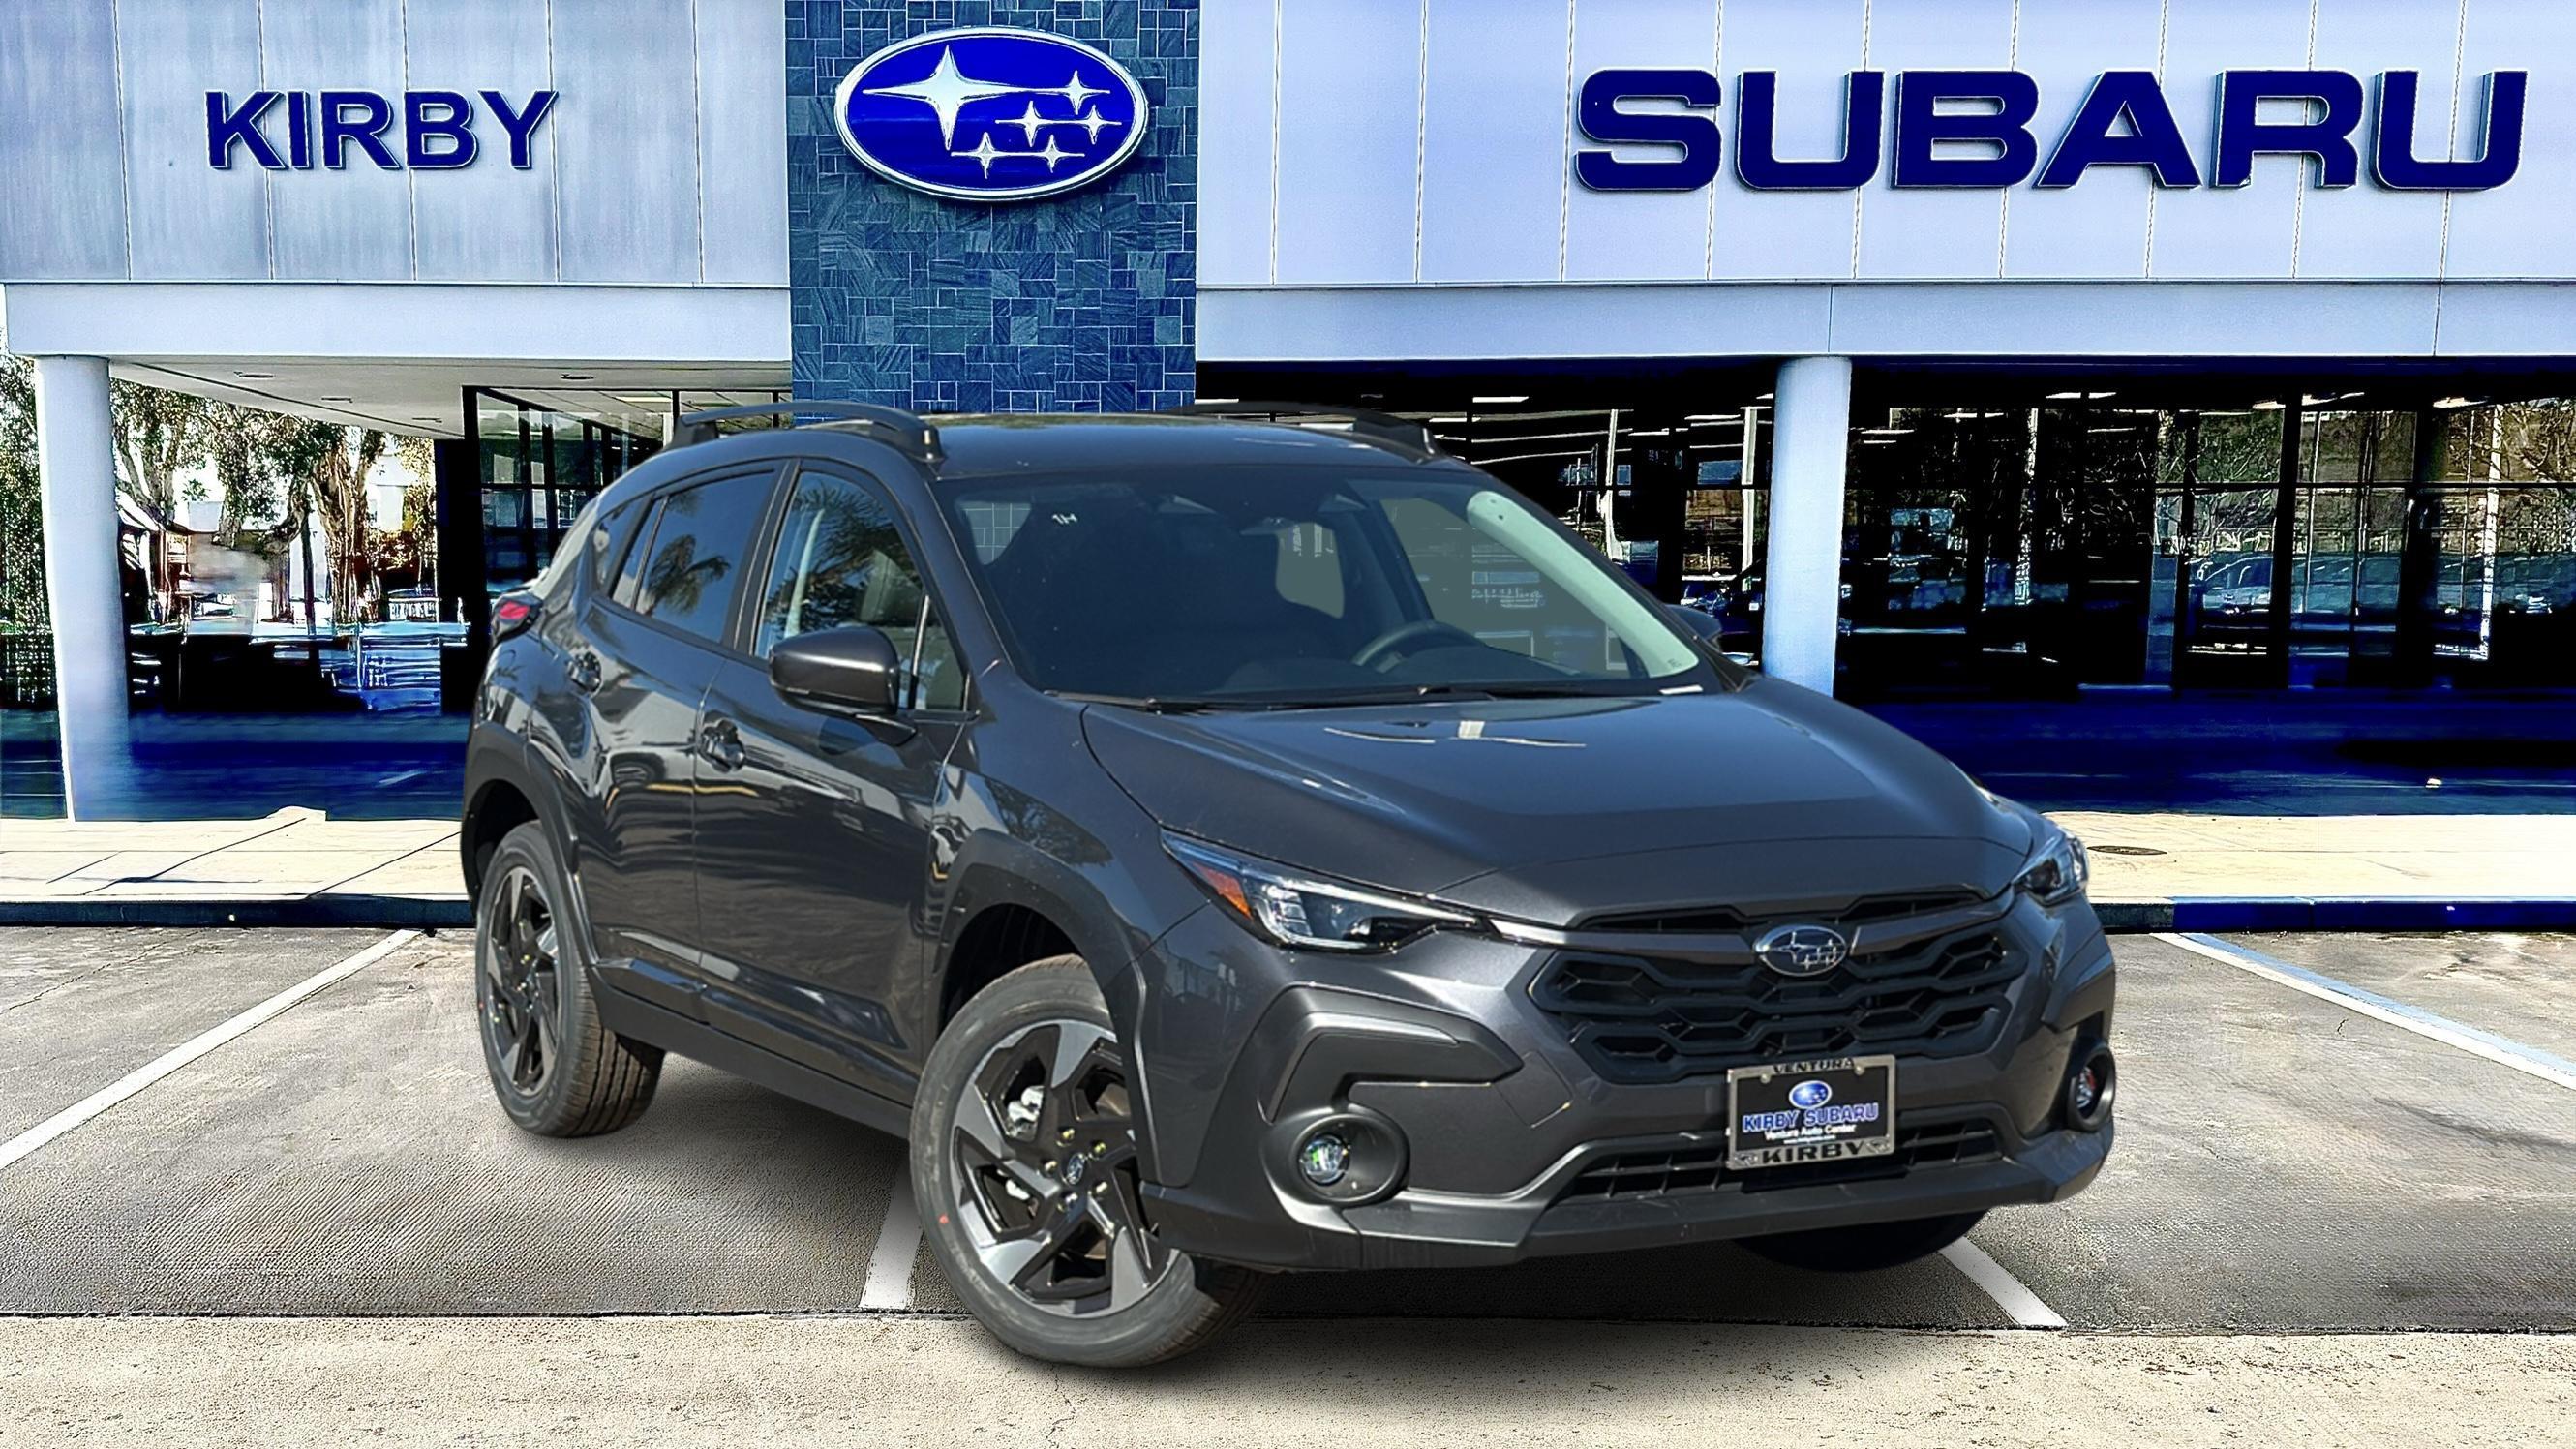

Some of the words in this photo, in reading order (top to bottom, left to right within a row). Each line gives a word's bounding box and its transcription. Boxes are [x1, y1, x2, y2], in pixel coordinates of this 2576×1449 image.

[206, 90, 559, 171] KIRBY
[1576, 69, 2527, 192] SUBARU
[1773, 1058, 1855, 1074] VENTURA
[1743, 1110, 1800, 1132] KIRBY
[1803, 1102, 1879, 1126] SUBARU
[1801, 1126, 1823, 1137] Auto
[1762, 1140, 1865, 1164] KIRBY
